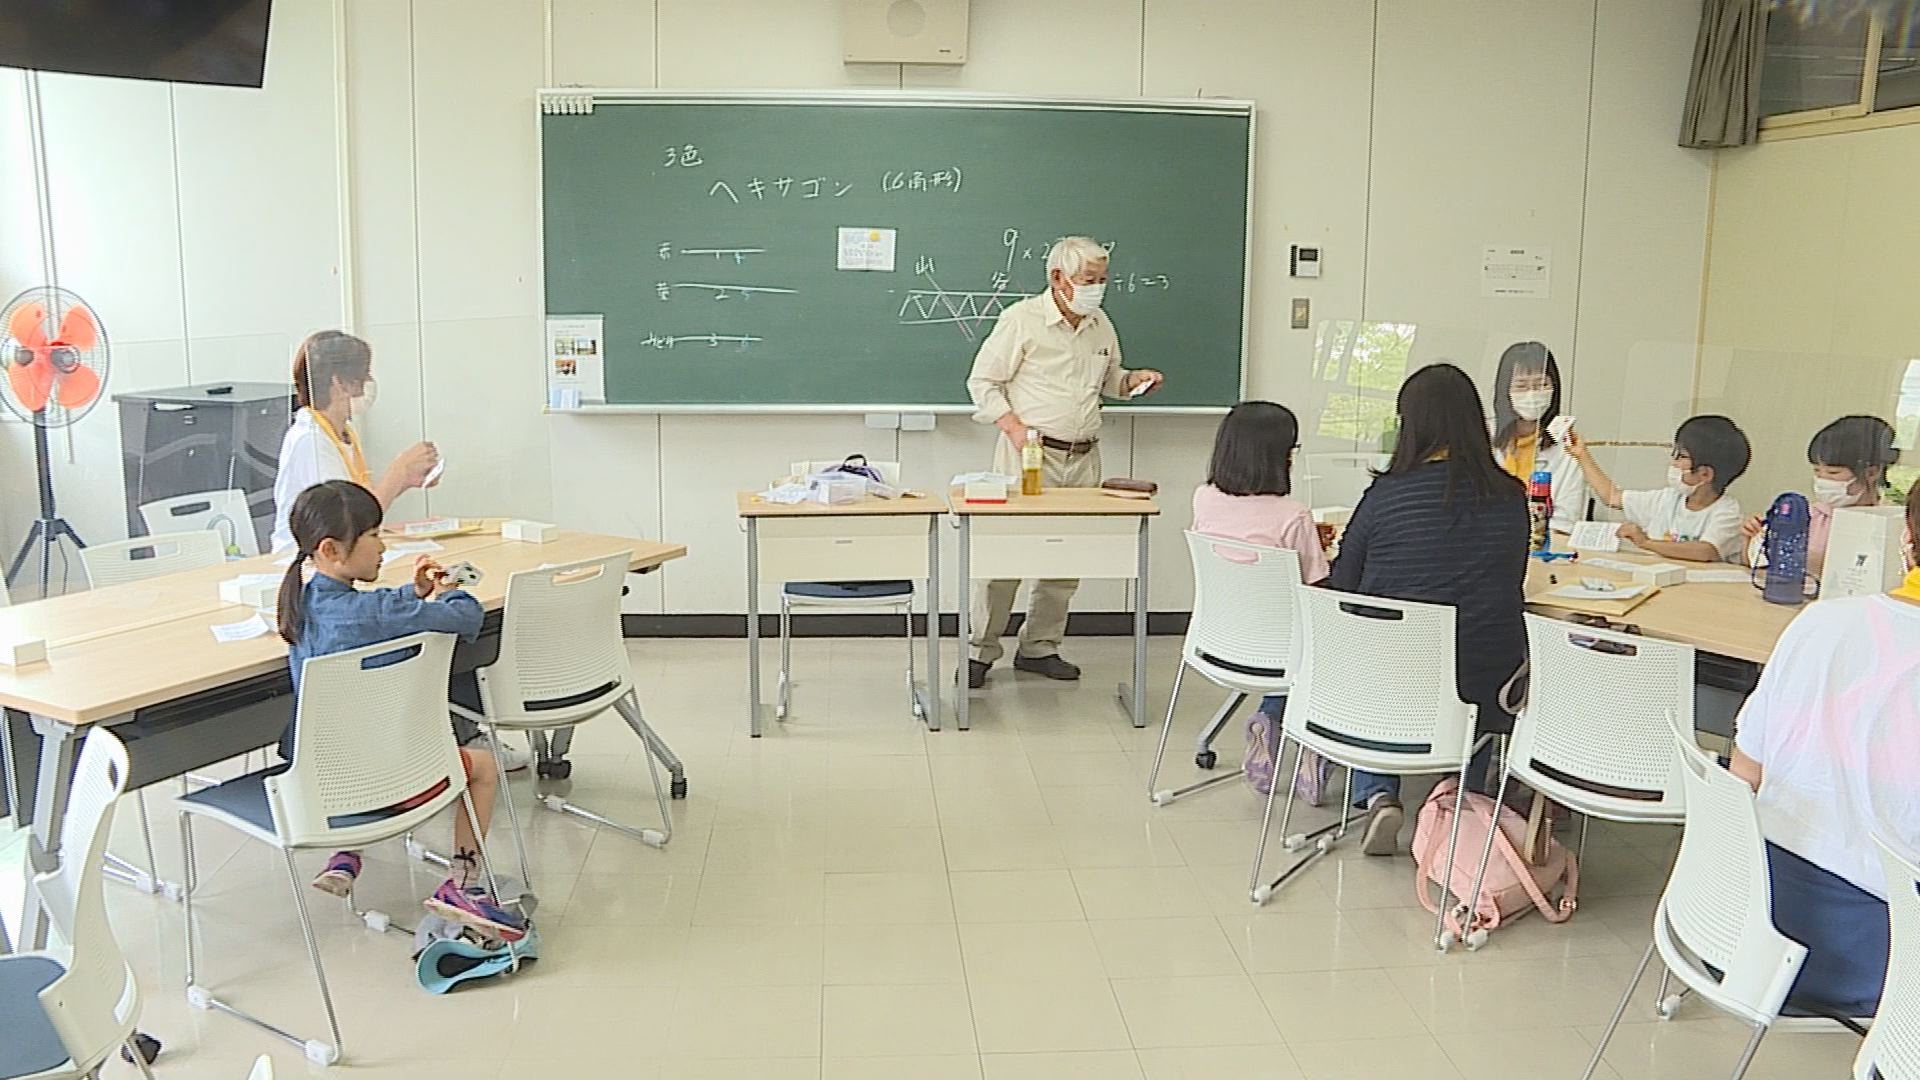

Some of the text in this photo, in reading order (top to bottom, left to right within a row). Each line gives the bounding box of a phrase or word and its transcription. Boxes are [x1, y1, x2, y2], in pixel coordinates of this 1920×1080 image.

[709, 166, 961, 203] ヘキサゴン (6角形)
